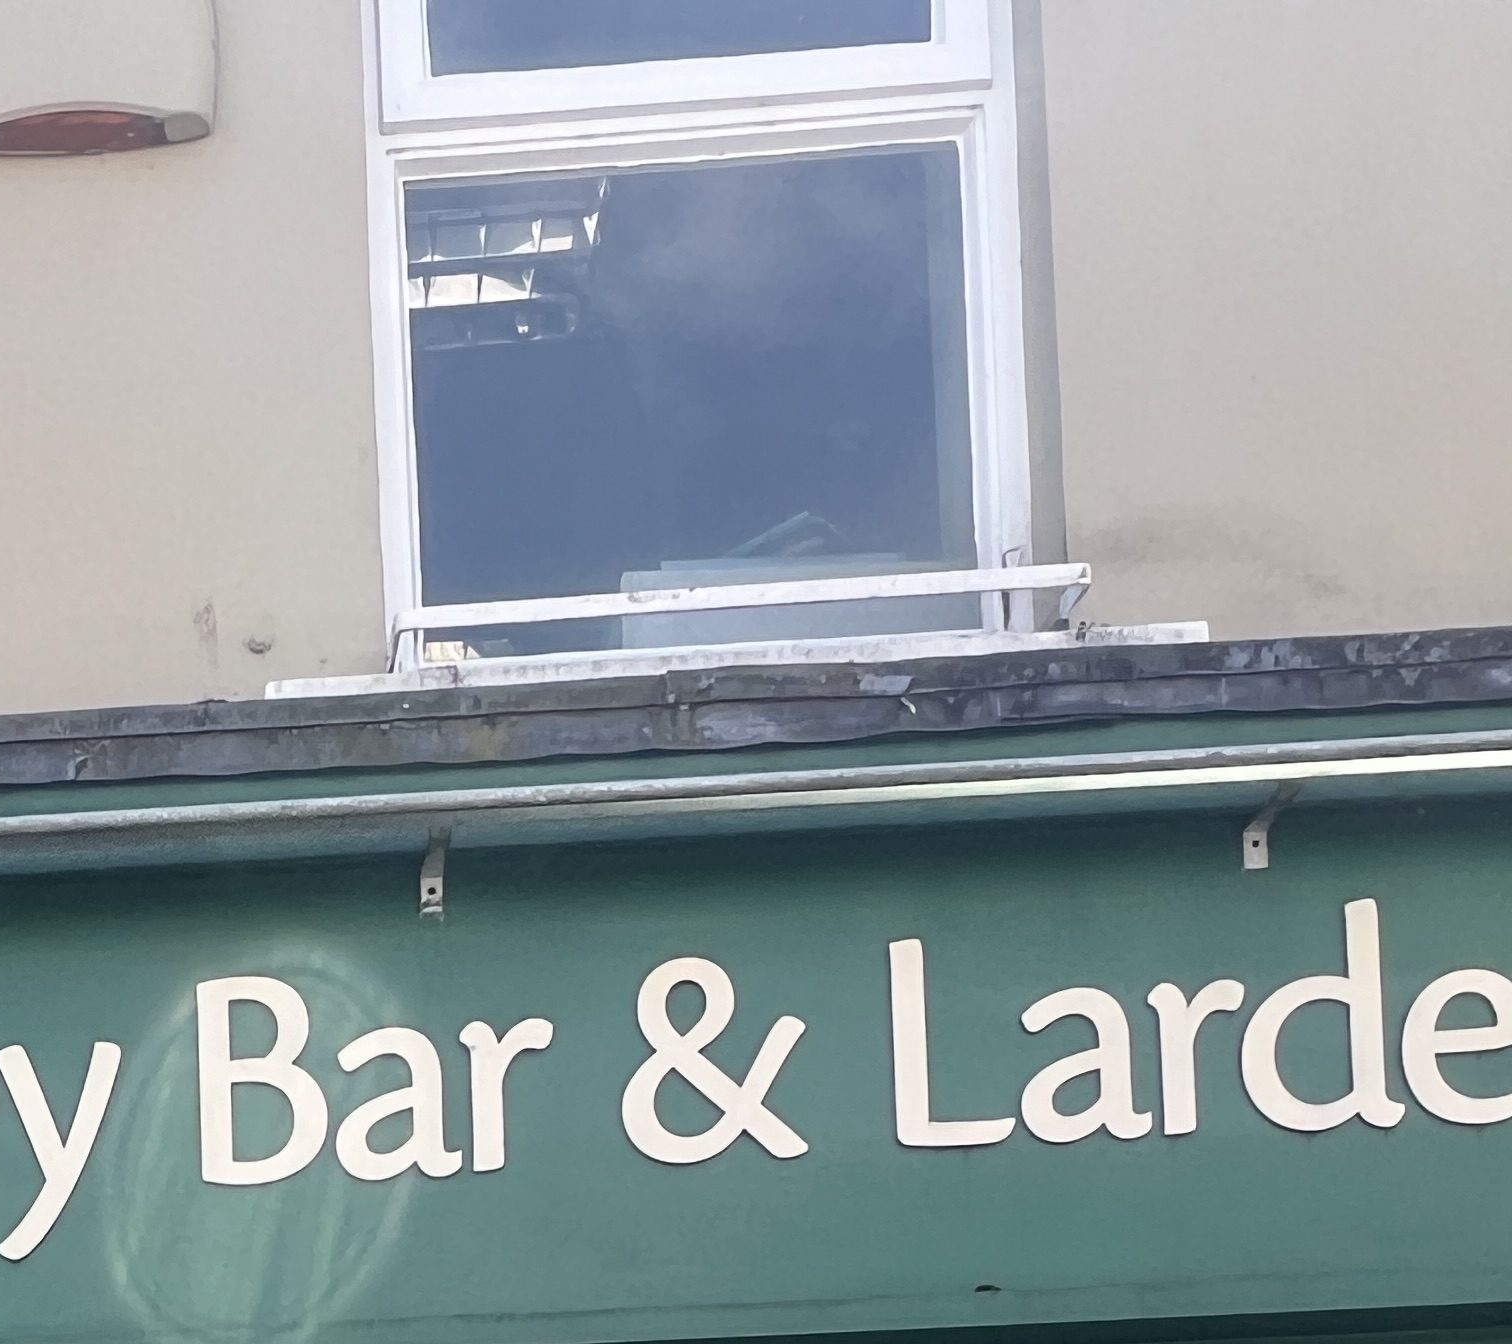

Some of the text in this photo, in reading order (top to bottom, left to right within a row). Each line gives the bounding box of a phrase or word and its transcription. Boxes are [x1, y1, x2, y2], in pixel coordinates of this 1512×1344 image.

[195, 975, 554, 1187] Bar
[621, 956, 810, 1165] &
[889, 897, 1512, 1147] Larde
